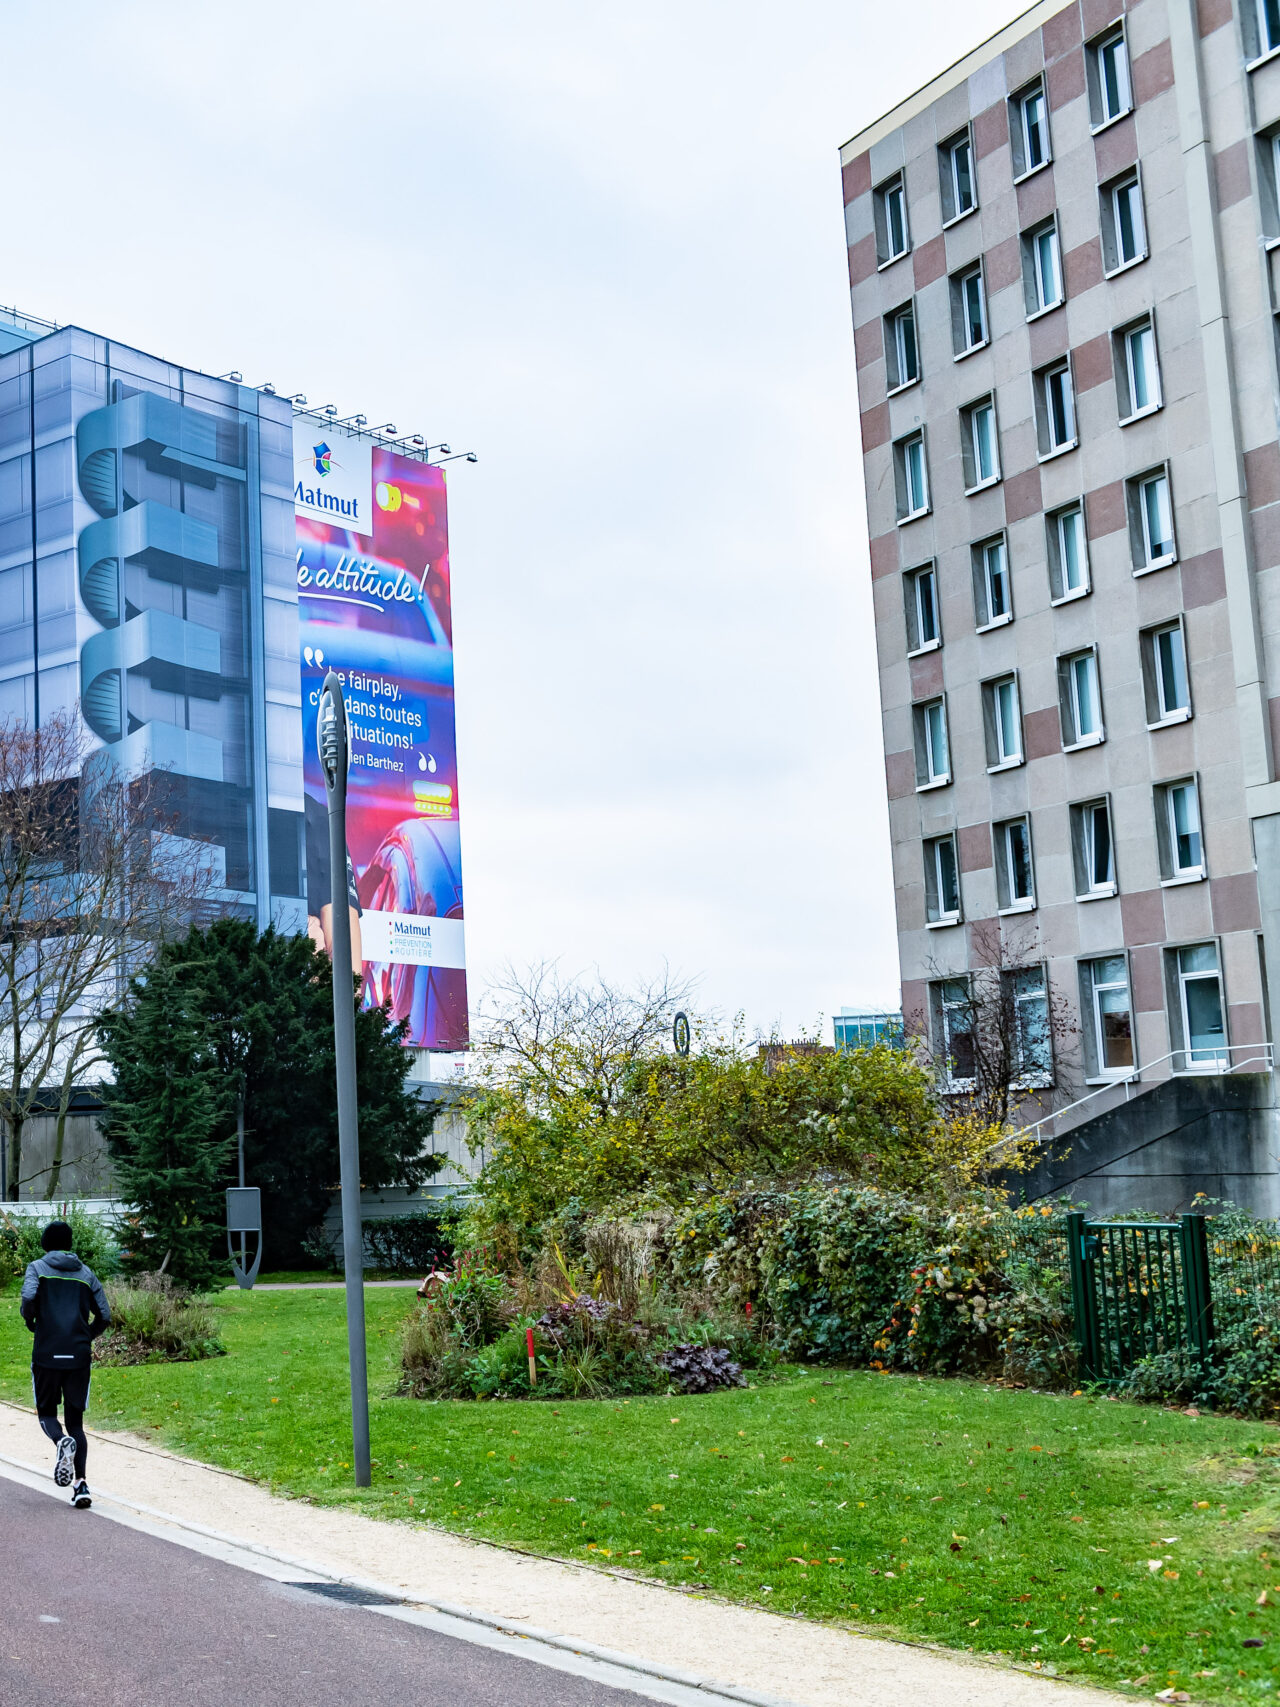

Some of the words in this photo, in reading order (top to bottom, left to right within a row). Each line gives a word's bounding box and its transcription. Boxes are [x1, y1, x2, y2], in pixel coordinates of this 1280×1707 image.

[348, 670, 402, 702] fairplay,
[344, 695, 377, 718] dans
[379, 703, 422, 727] toutes
[349, 720, 414, 750] ituations!
[366, 753, 405, 773] Barthez
[394, 921, 431, 937] Matmut
